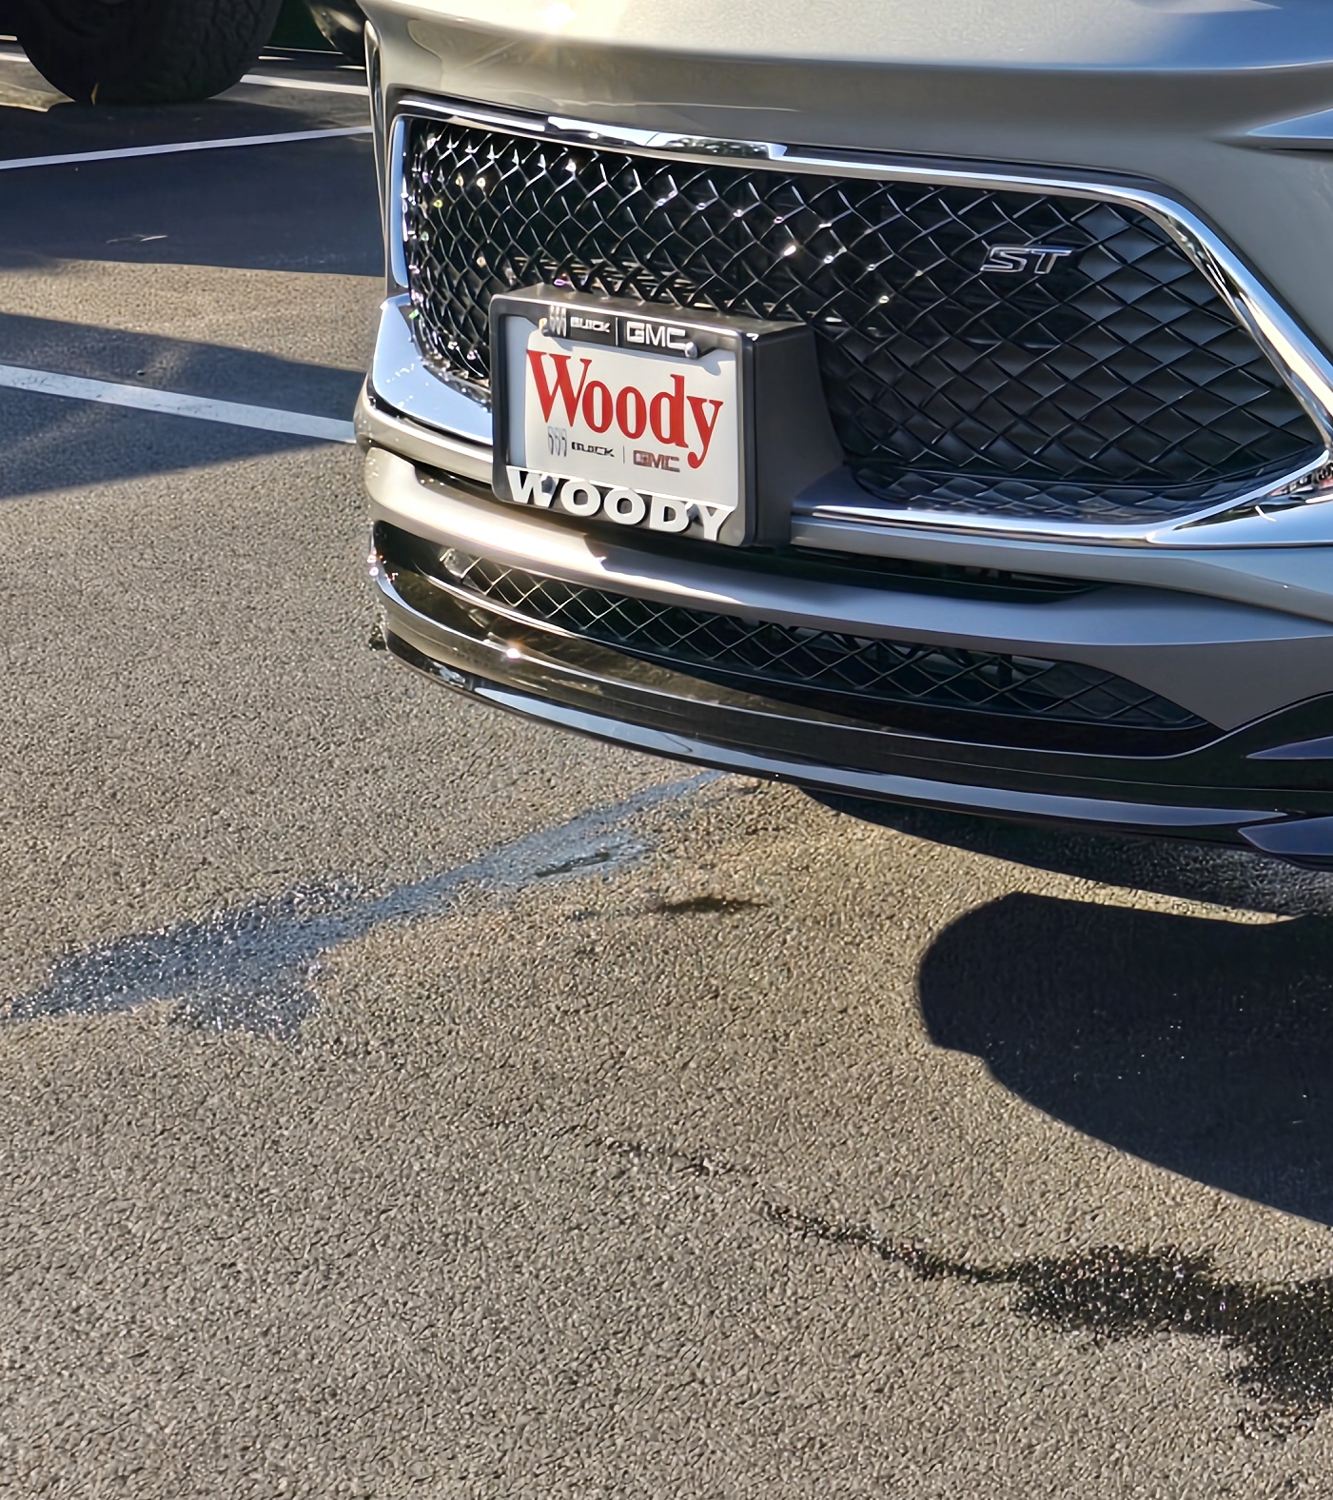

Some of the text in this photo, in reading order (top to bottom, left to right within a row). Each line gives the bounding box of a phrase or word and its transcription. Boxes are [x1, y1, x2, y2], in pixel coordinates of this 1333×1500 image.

[980, 245, 1073, 274] ST
[570, 316, 686, 349] BUICK GMC
[526, 349, 724, 469] Woody
[506, 465, 734, 541] WOODY
